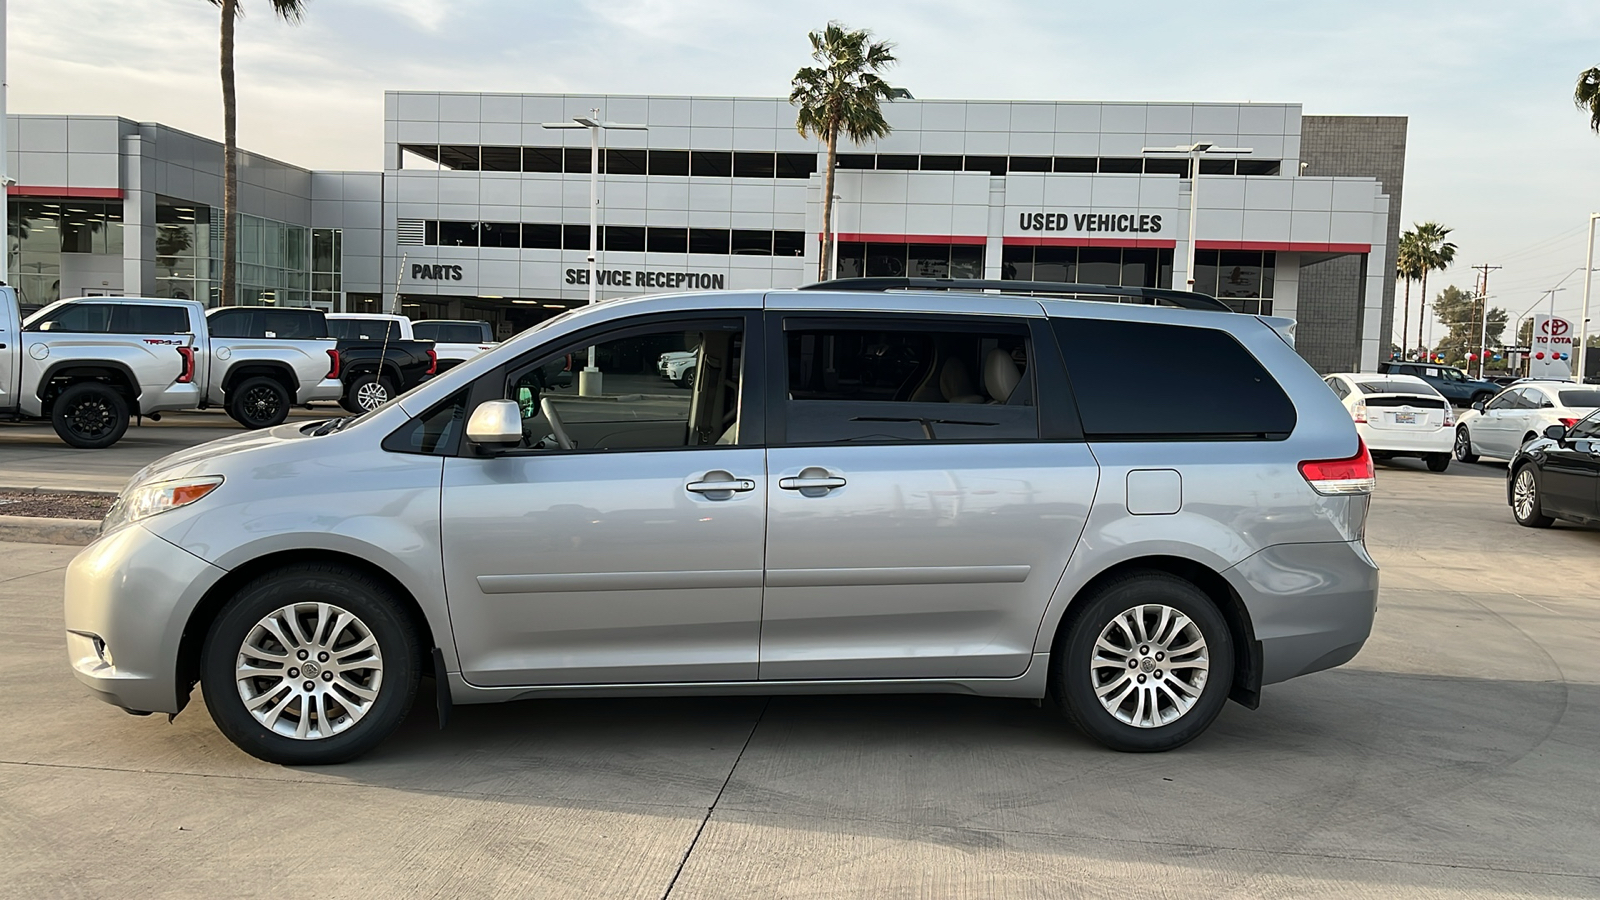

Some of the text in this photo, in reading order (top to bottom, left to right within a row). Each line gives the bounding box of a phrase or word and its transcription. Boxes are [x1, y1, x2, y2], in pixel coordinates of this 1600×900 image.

[1020, 213, 1162, 233] USED VEHICLES
[411, 264, 462, 281] PARTS
[635, 270, 724, 290] RECEPTION
[1536, 336, 1572, 344] TOYOTA
